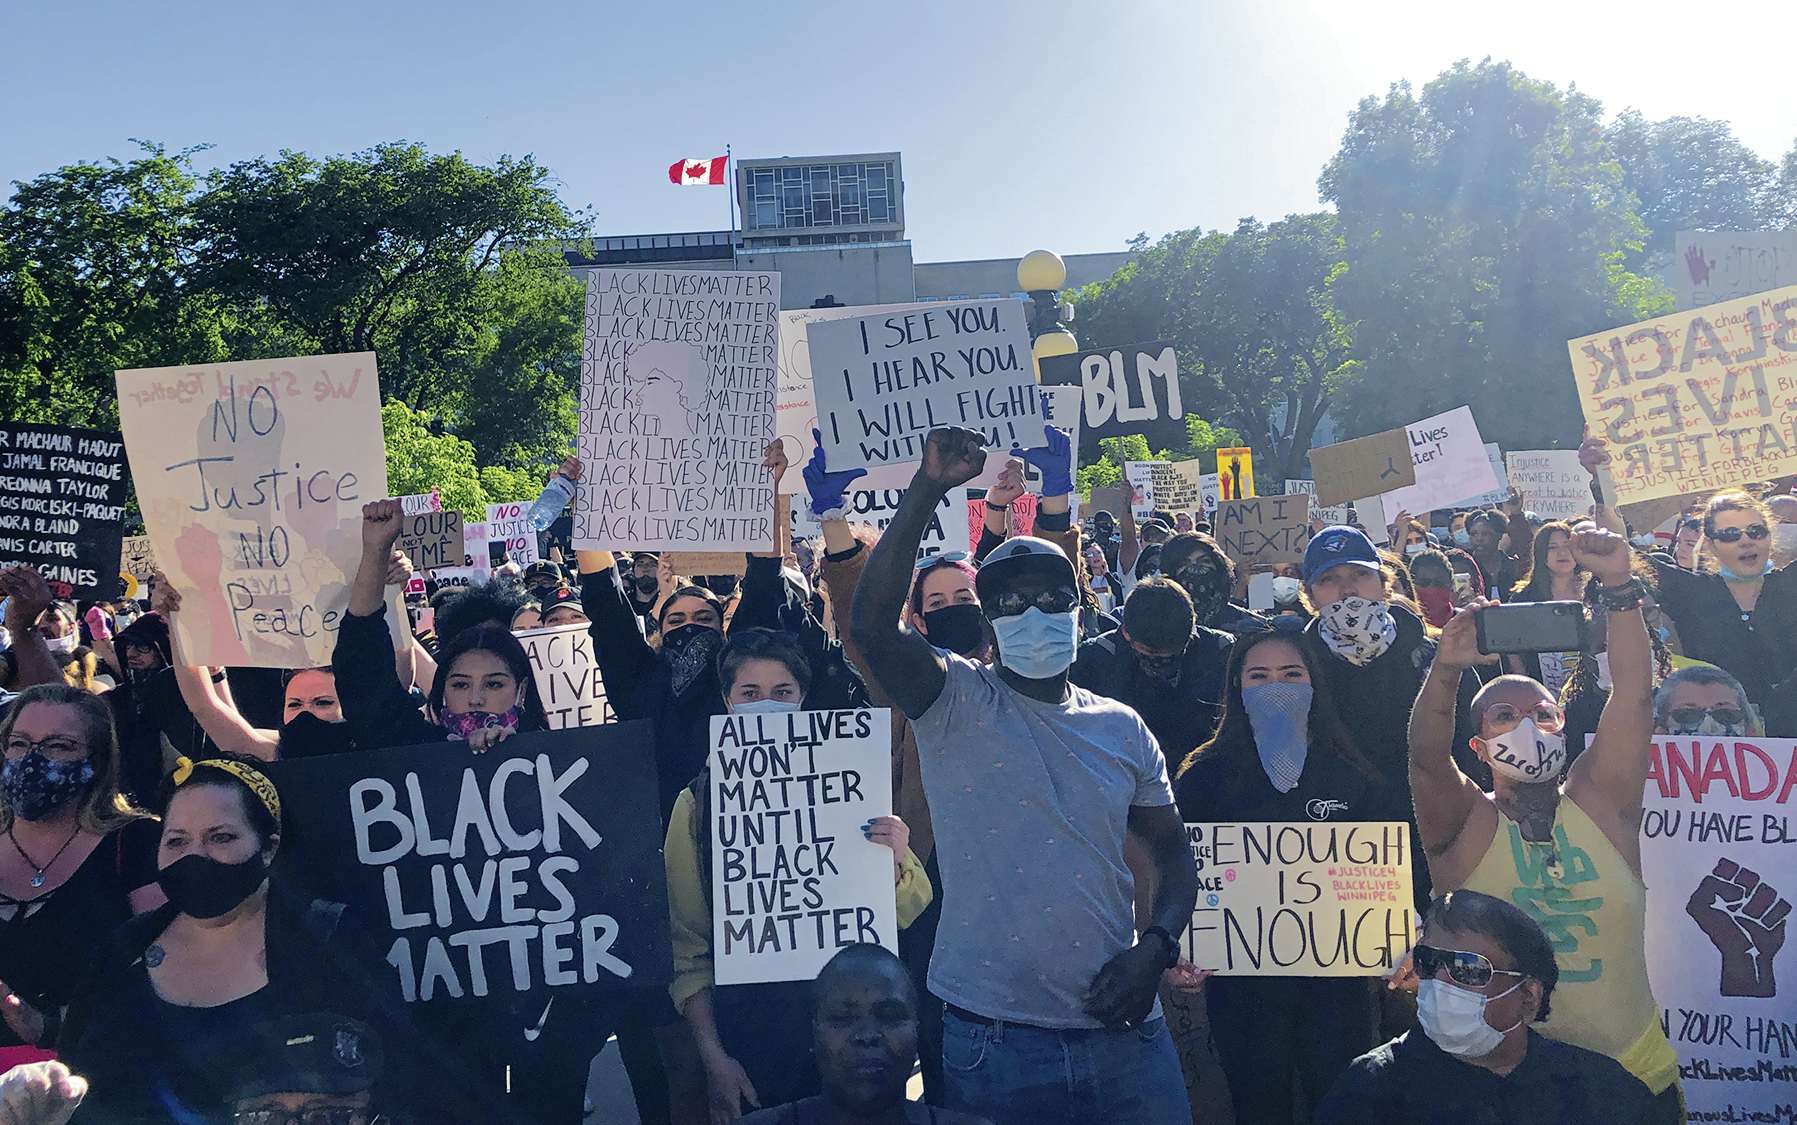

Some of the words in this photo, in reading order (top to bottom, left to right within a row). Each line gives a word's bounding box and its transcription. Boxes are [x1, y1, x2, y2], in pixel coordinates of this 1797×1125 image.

[587, 271, 647, 294] BLACK
[652, 272, 698, 295] LIVES
[699, 275, 772, 296] MATTER
[586, 294, 652, 317] BLACK
[657, 297, 704, 320] LIVES
[707, 299, 776, 322] MATTER
[585, 316, 645, 339] BLACK
[651, 319, 702, 341] LIVES
[705, 322, 775, 344] MATTER
[860, 321, 869, 355] I
[884, 312, 940, 348] SEE
[946, 307, 1006, 334] YOU.
[1652, 324, 1681, 340] for
[581, 338, 634, 361] BLACK
[706, 344, 774, 363] MATTER
[580, 361, 632, 386] BLACK
[711, 365, 775, 388] MATTER
[843, 369, 854, 402] I
[872, 352, 955, 395] HEAR
[958, 343, 1024, 379] YOU.
[580, 386, 633, 411] BLACK
[706, 389, 775, 412] MATTER
[1080, 347, 1183, 428] BLM
[212, 375, 278, 443] NO
[830, 412, 840, 445] I
[857, 398, 948, 438] WILL
[956, 384, 1036, 423] FIGHT
[1672, 399, 1699, 414] for
[578, 411, 638, 435] BLACK
[696, 413, 774, 436] MATTER
[980, 420, 1020, 448] U!
[1409, 426, 1448, 446] Lives
[577, 435, 639, 459] BLACK
[645, 438, 702, 460] LIVES
[707, 437, 769, 459] MATTER
[2, 452, 47, 470] JAMAL
[50, 456, 122, 481] FRANCIQUE
[577, 461, 637, 486] BLACK
[643, 461, 707, 485] LIVES
[712, 460, 774, 486] MATTER
[1511, 472, 1556, 484] ANYWHERE
[1676, 464, 1779, 493] WINNIPEG
[0, 476, 52, 494] REONNA
[57, 478, 110, 501] TAYLOR
[165, 456, 359, 511] Justice
[496, 506, 521, 520] NO
[576, 486, 640, 513] BLACK
[648, 486, 708, 512] LIVES
[711, 487, 774, 512] MATTER
[1224, 502, 1262, 526] AM
[1272, 500, 1288, 521] I
[34, 518, 79, 535] BLAND
[400, 512, 458, 538] LOUR
[490, 520, 534, 538] JUSTICE
[574, 514, 638, 541] BLACK
[645, 516, 699, 541] LIVES
[702, 517, 772, 542] MATTER
[1224, 522, 1308, 556] NEXT?
[28, 539, 78, 559] CARTER
[239, 525, 290, 568] NO
[402, 538, 423, 547] NOT
[506, 537, 527, 551] NO
[512, 549, 534, 564] ACE
[37, 563, 98, 587] GAINES
[227, 582, 341, 641] Peace
[528, 635, 589, 671] ACK
[549, 668, 607, 704] IVE
[718, 715, 776, 747] ALL
[787, 711, 872, 743] LIVES
[717, 742, 823, 780] WON'T
[1647, 741, 1797, 804] ANADA
[719, 770, 864, 814] MATTER
[349, 753, 602, 865] BLACK
[718, 808, 835, 848] UNTIL
[1641, 808, 1681, 839] OU
[1688, 811, 1755, 843] HAVE
[1192, 845, 1212, 859] TICE
[1213, 825, 1404, 867] ENOUGH
[723, 842, 839, 882] BLACK
[383, 856, 581, 928] LIVES
[724, 877, 824, 916] LIVES
[1197, 876, 1224, 892] ACE
[1278, 870, 1322, 905] IS
[1336, 891, 1397, 902] WINNIPEG
[724, 906, 882, 955] MATTER
[1189, 906, 1411, 971] ENOUGH
[1678, 1008, 1743, 1049] YOUR
[1745, 1016, 1797, 1059] HAN
